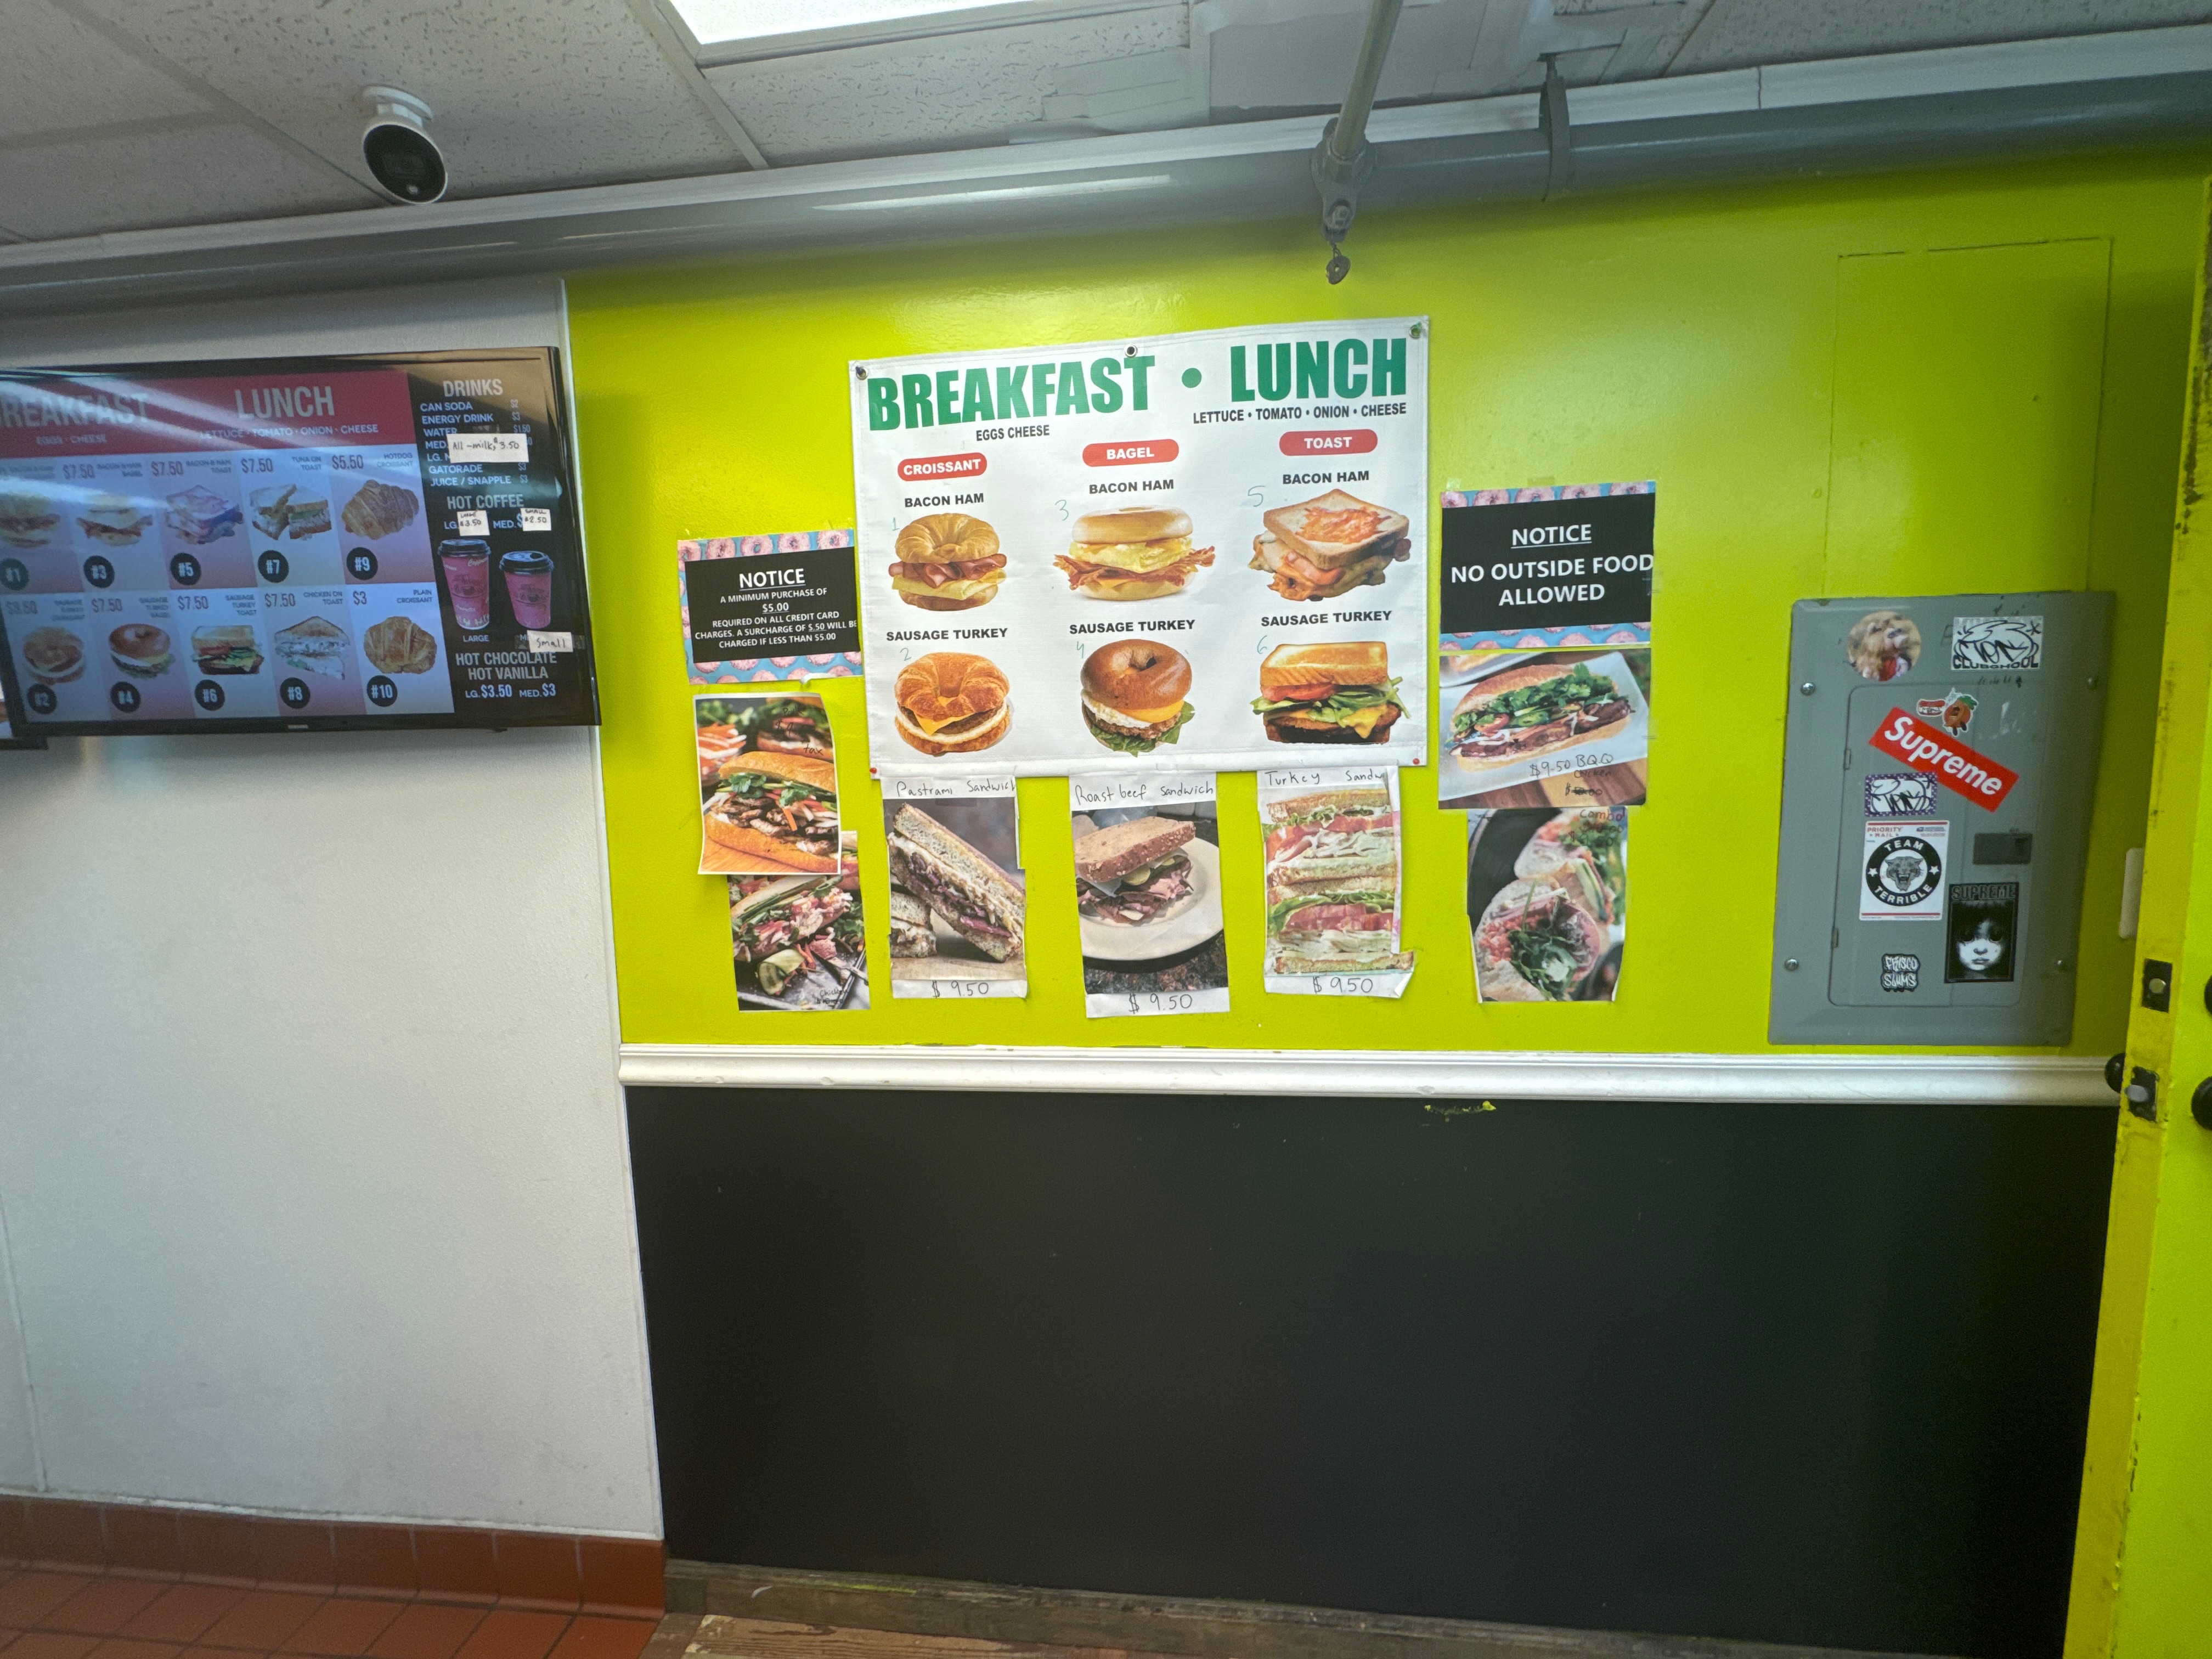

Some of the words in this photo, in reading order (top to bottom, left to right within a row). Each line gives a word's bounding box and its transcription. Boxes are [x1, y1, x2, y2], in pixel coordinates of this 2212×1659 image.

[443, 379, 503, 397] DRINKS
[867, 356, 1155, 431] BREAKFAST
[1231, 338, 1407, 402] LUNCH
[234, 386, 335, 419] LUNCH
[420, 402, 443, 411] CAN
[444, 402, 473, 410] SODA
[421, 414, 461, 424] ENERGY
[464, 413, 494, 422] DRINK
[512, 411, 520, 421] $3
[1193, 410, 1244, 424] LETTUCE
[1256, 407, 1302, 420] TOMATO
[1313, 405, 1349, 419] ONION
[1361, 403, 1406, 416] CHEESE
[300, 426, 333, 435] ONION
[341, 424, 379, 433] CHEESE
[424, 427, 457, 437] WATER
[976, 427, 1004, 441] EGGS
[1008, 425, 1049, 438] CHEESE
[1304, 437, 1352, 449] TOAST
[1107, 447, 1154, 460] BAGEL
[151, 461, 184, 476] $7.50
[241, 458, 274, 473] $7.50
[332, 454, 364, 470] $5.50
[429, 464, 483, 475] GATORADE
[904, 459, 981, 475] CROISSANT
[431, 477, 458, 487] JUICE
[468, 476, 511, 485] SNAPPLE
[1283, 473, 1331, 484] BACON
[1337, 471, 1369, 482] HAM
[1090, 482, 1137, 494] BACON
[1143, 479, 1173, 491] HAM
[447, 496, 472, 510] HOT
[476, 494, 524, 509] COFFEE
[905, 496, 950, 507] BACON
[955, 493, 984, 504] HAM
[1248, 486, 1266, 507] 5
[1054, 499, 1069, 521] 3
[892, 517, 900, 531] 1
[1511, 524, 1592, 546] NOTICE
[266, 559, 280, 574] #7
[354, 556, 370, 572] #9
[1451, 566, 1484, 583] NO
[1491, 558, 1585, 580] OUTSIDE
[1593, 554, 1654, 574] FOOD
[739, 568, 805, 589] NOTICE
[264, 593, 296, 608] $7.50
[353, 591, 367, 605] $3
[728, 592, 769, 602] MINIMUM
[771, 589, 815, 599] PURCHASE
[816, 588, 827, 596] OF
[1498, 584, 1605, 606] ALLOWED
[177, 596, 209, 610] $7.50
[762, 602, 789, 613] $5.00
[713, 618, 752, 628] REQUIRED
[770, 615, 784, 623] ALL
[786, 613, 814, 622] CREDIT
[816, 611, 839, 620] CARD
[1070, 622, 1133, 634] SAUSAGE
[1138, 619, 1195, 631] TURKEY
[1261, 613, 1328, 627] SAUSAGE
[1333, 611, 1392, 622] TURKEY
[695, 629, 735, 639] CHARGES.
[744, 625, 793, 636] SURCHARGE
[827, 621, 847, 629] WILL
[887, 630, 949, 641] SAUSAGE
[953, 628, 1008, 639] TURKEY
[537, 637, 565, 648] Small
[719, 638, 758, 648] CHARGED
[769, 636, 787, 645] LESS
[789, 635, 812, 644] THAN
[815, 633, 836, 642] $5.00
[1257, 635, 1267, 654] 6
[455, 653, 479, 665] HOT
[484, 651, 557, 665] CHOCOLATE
[900, 647, 912, 661] 2
[469, 667, 493, 680] HOT
[495, 666, 548, 679] VANILLA
[202, 687, 217, 702] #6
[287, 686, 303, 701] #8
[371, 684, 393, 699] #10
[481, 684, 512, 698] $3.50
[542, 682, 556, 696] $3
[1884, 716, 2002, 795] Supreme
[1264, 770, 1321, 786] Turkey
[896, 781, 953, 797] Pastrami
[1884, 839, 1924, 851] TEAM
[1875, 884, 1933, 904] TERRIBLE
[1951, 884, 2016, 900] SUPREME
[1884, 956, 1919, 970] FRISCO
[1883, 974, 1917, 987] SLUMS
